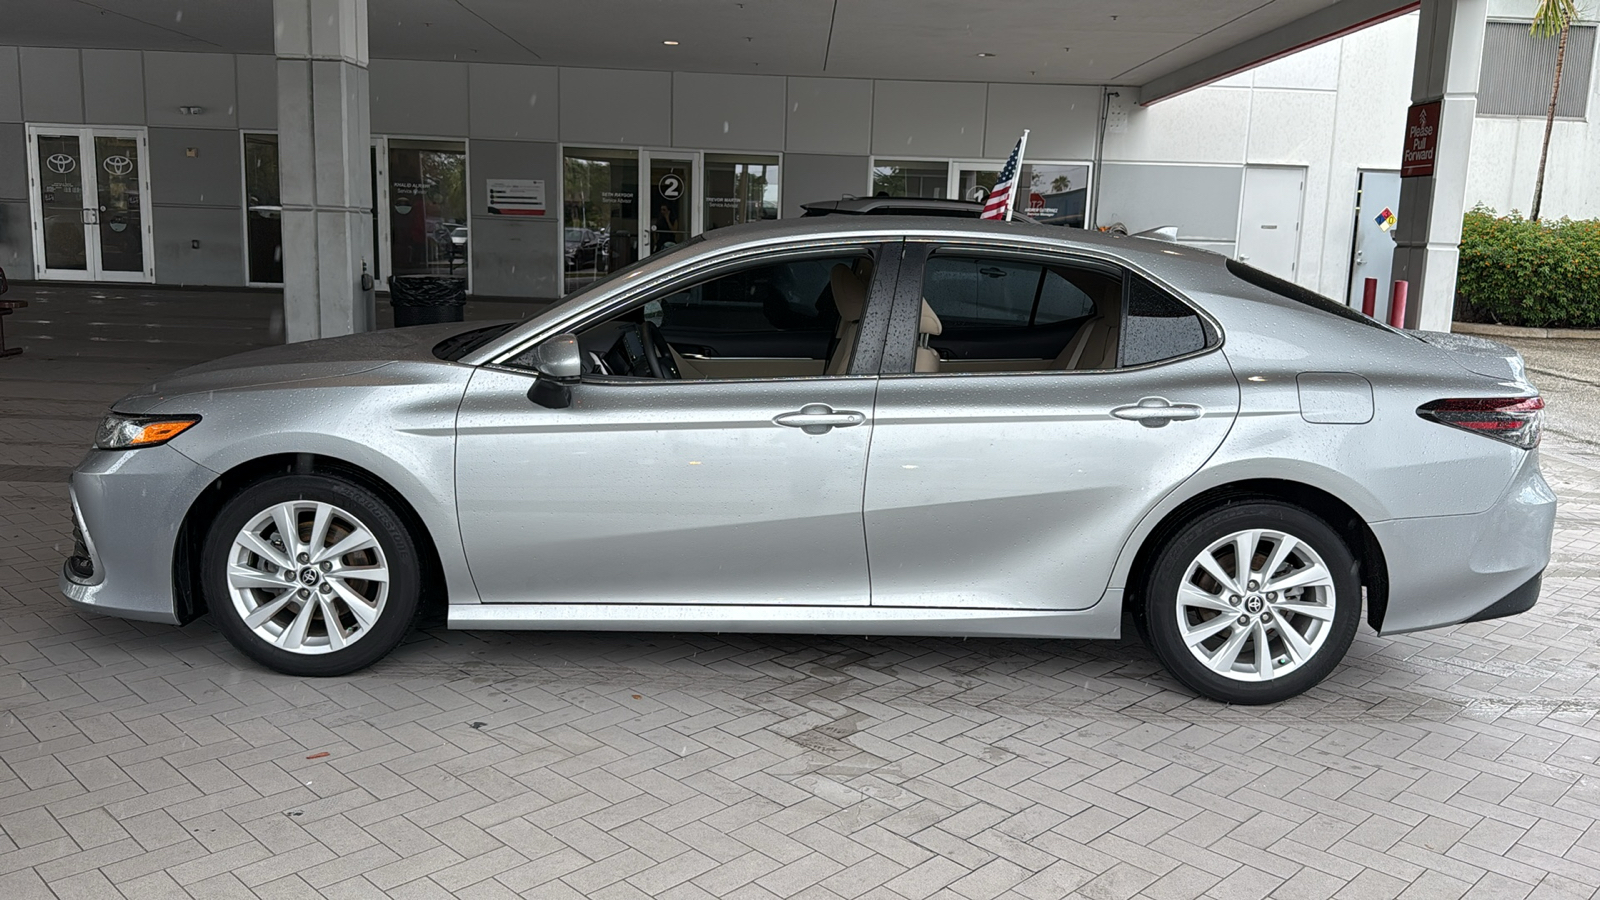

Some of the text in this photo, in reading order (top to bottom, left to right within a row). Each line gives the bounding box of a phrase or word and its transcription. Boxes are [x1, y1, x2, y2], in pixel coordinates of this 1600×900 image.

[1409, 125, 1433, 138] Please
[1413, 137, 1427, 150] Pull
[1404, 147, 1434, 162] Forward
[664, 178, 679, 197] 2
